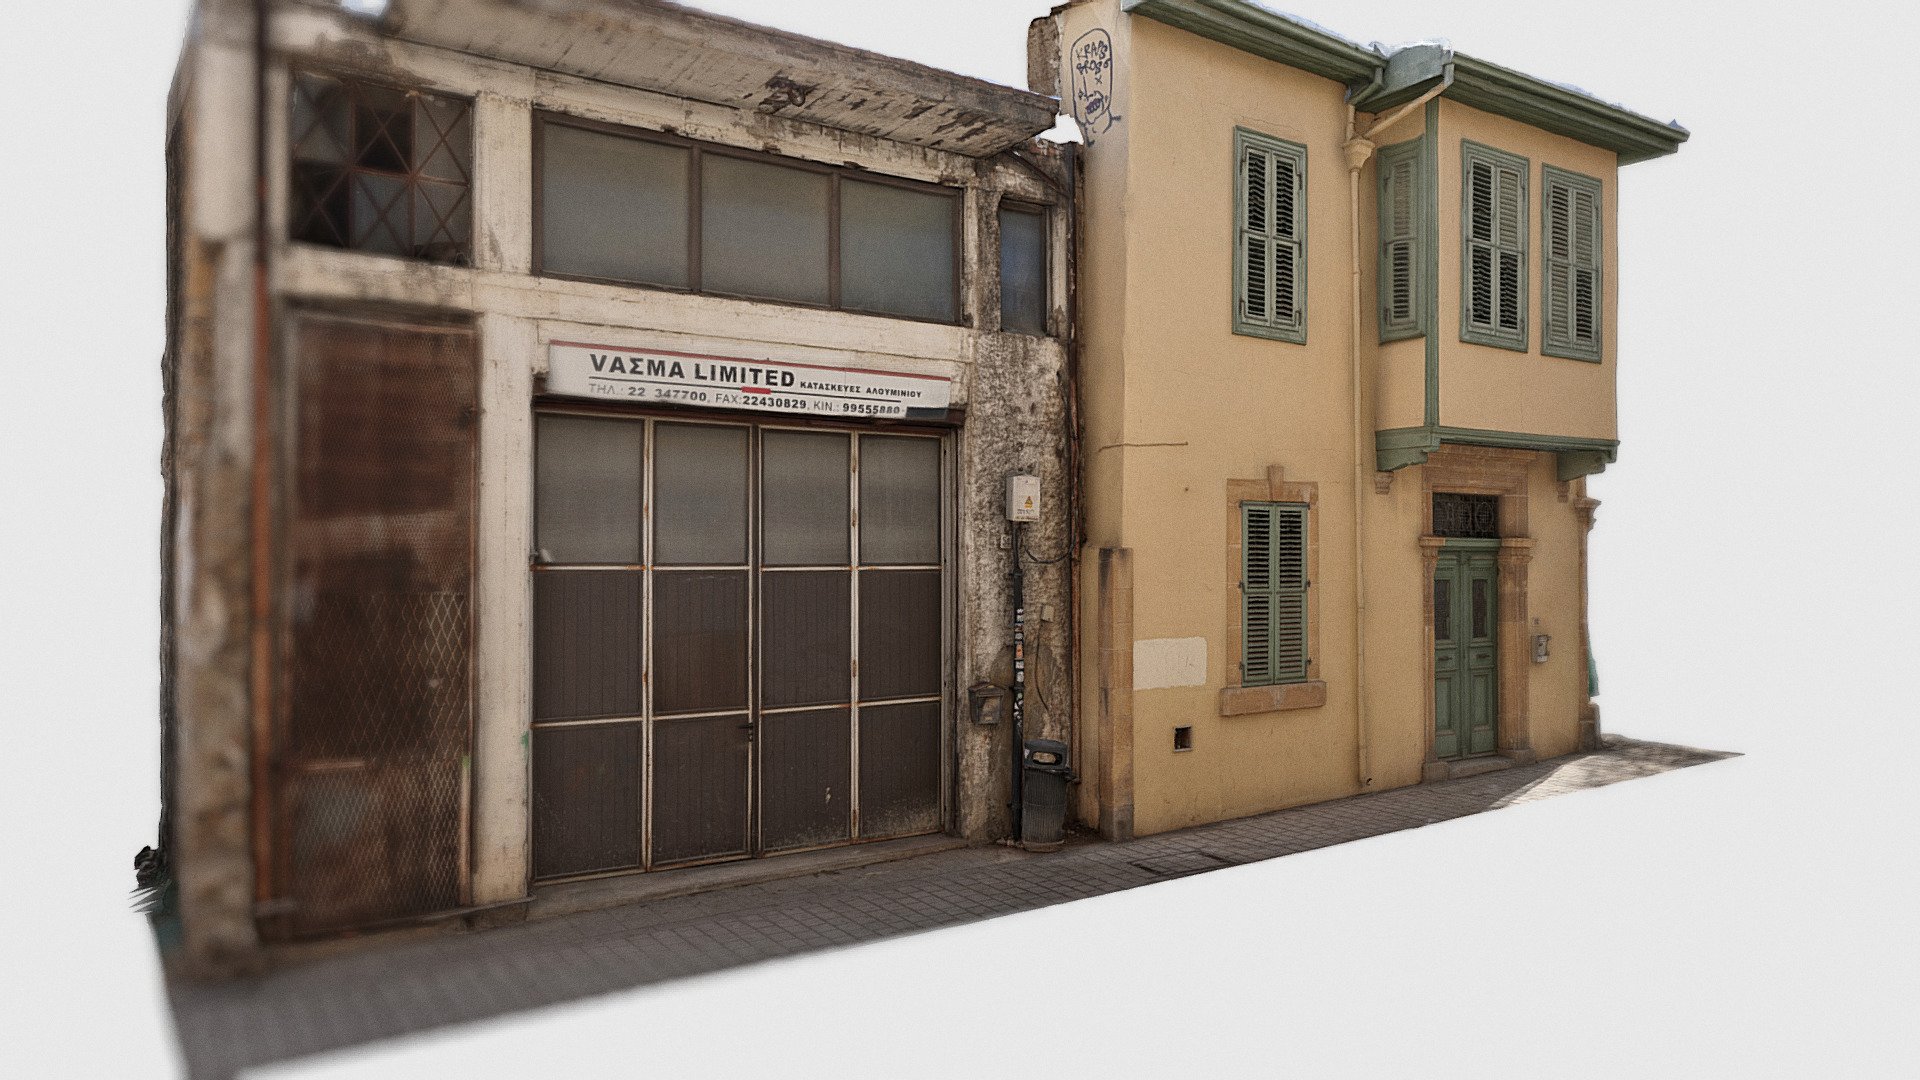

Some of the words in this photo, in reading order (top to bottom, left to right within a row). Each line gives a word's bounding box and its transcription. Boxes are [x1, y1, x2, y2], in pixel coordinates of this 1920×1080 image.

[694, 363, 795, 387] LIMITED
[628, 387, 646, 397] 22
[800, 381, 861, 393] ΚΑΤΑΣΚΕΥΕΣ
[866, 387, 922, 398] ΑΛΟΥΜΙΝΙΟΥ
